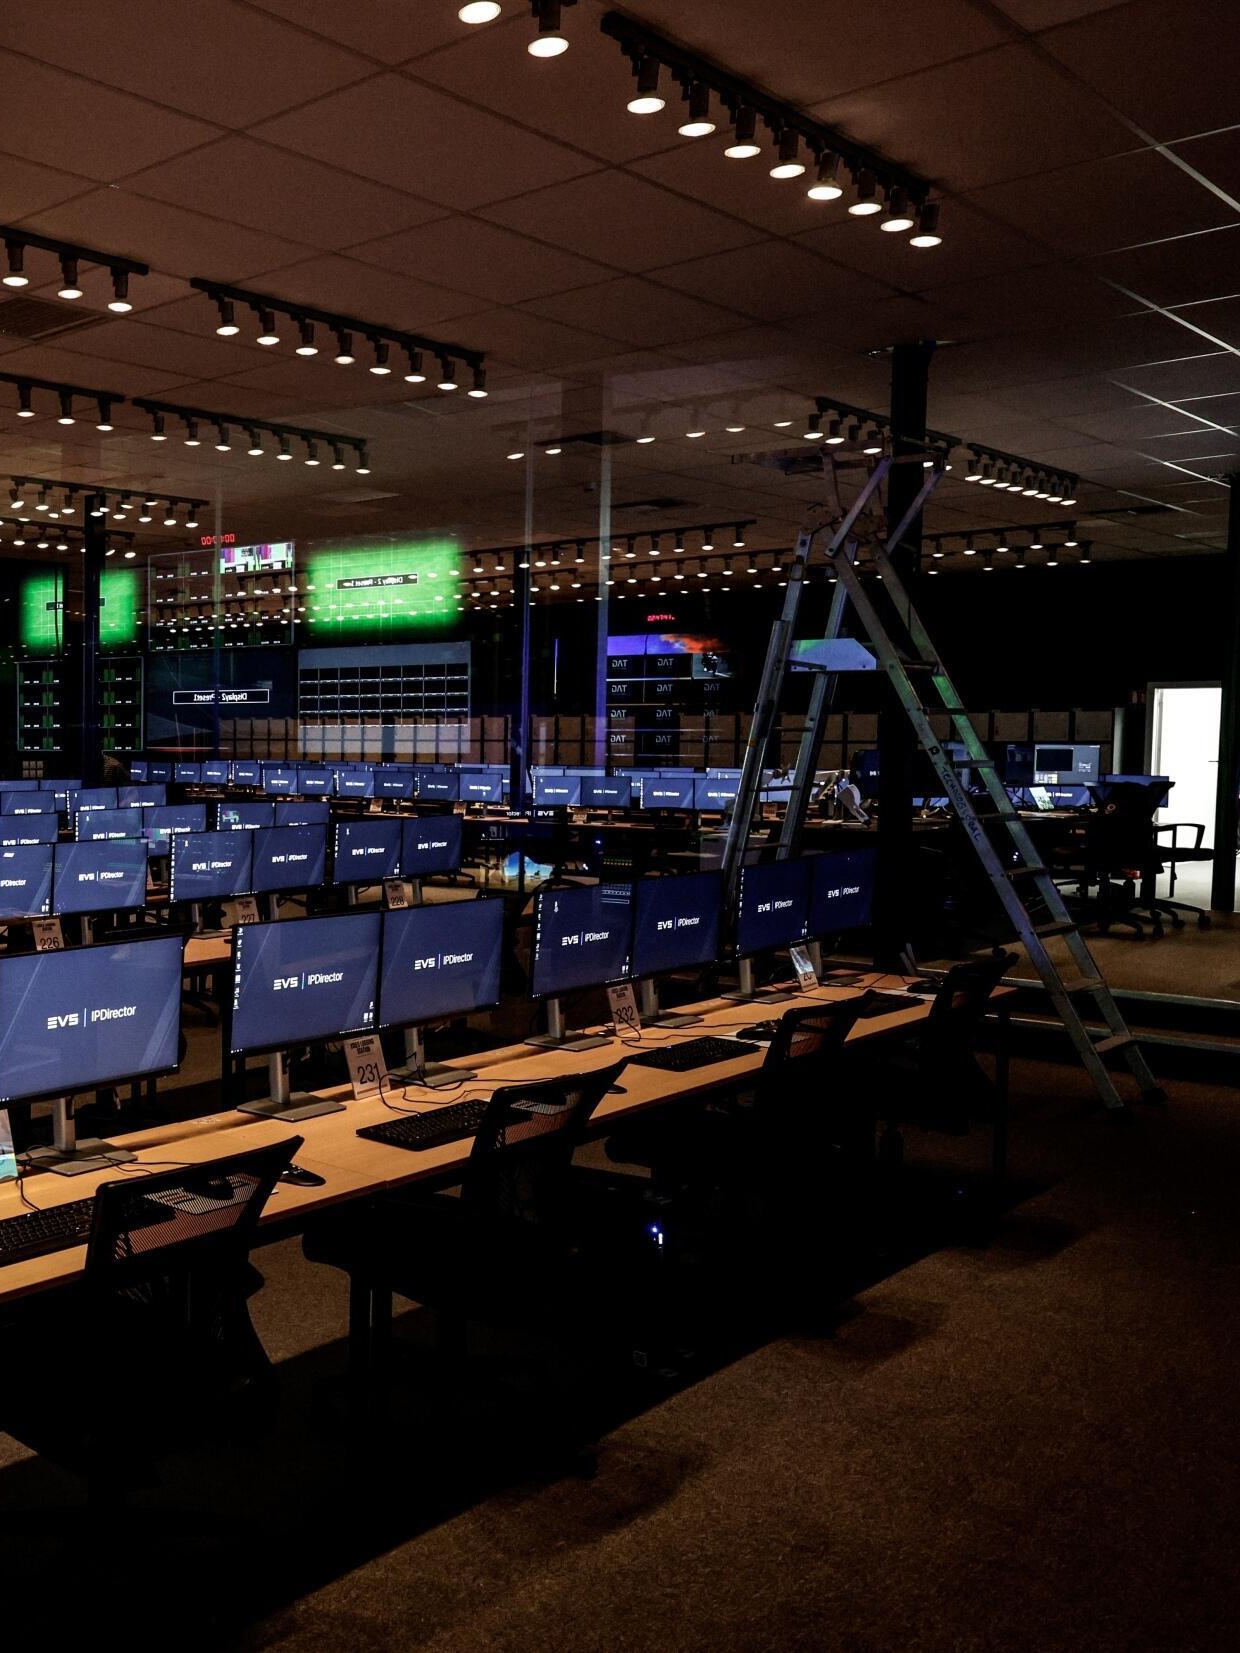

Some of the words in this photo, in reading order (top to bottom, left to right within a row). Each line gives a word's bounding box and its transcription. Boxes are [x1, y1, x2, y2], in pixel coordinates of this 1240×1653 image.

[192, 863, 206, 871] EVS
[79, 873, 94, 881] EVS
[828, 890, 839, 898] EVS
[843, 887, 859, 895] IPDirector
[758, 903, 770, 912] EVS
[775, 900, 792, 909] IPDirector
[241, 914, 255, 923] 227
[658, 920, 672, 930] EVS
[678, 918, 699, 926] IPDirector
[40, 937, 60, 950] 226
[562, 935, 578, 945] EVS
[585, 932, 609, 941] IPDirector
[415, 958, 435, 970] EVS
[443, 953, 473, 965] IPDirector
[274, 977, 298, 990] EVS
[308, 973, 343, 985] IPDirector
[48, 1014, 78, 1029] EVS
[92, 1006, 136, 1021] IPDirector
[616, 1005, 635, 1024] 232
[357, 1062, 380, 1084] 231
